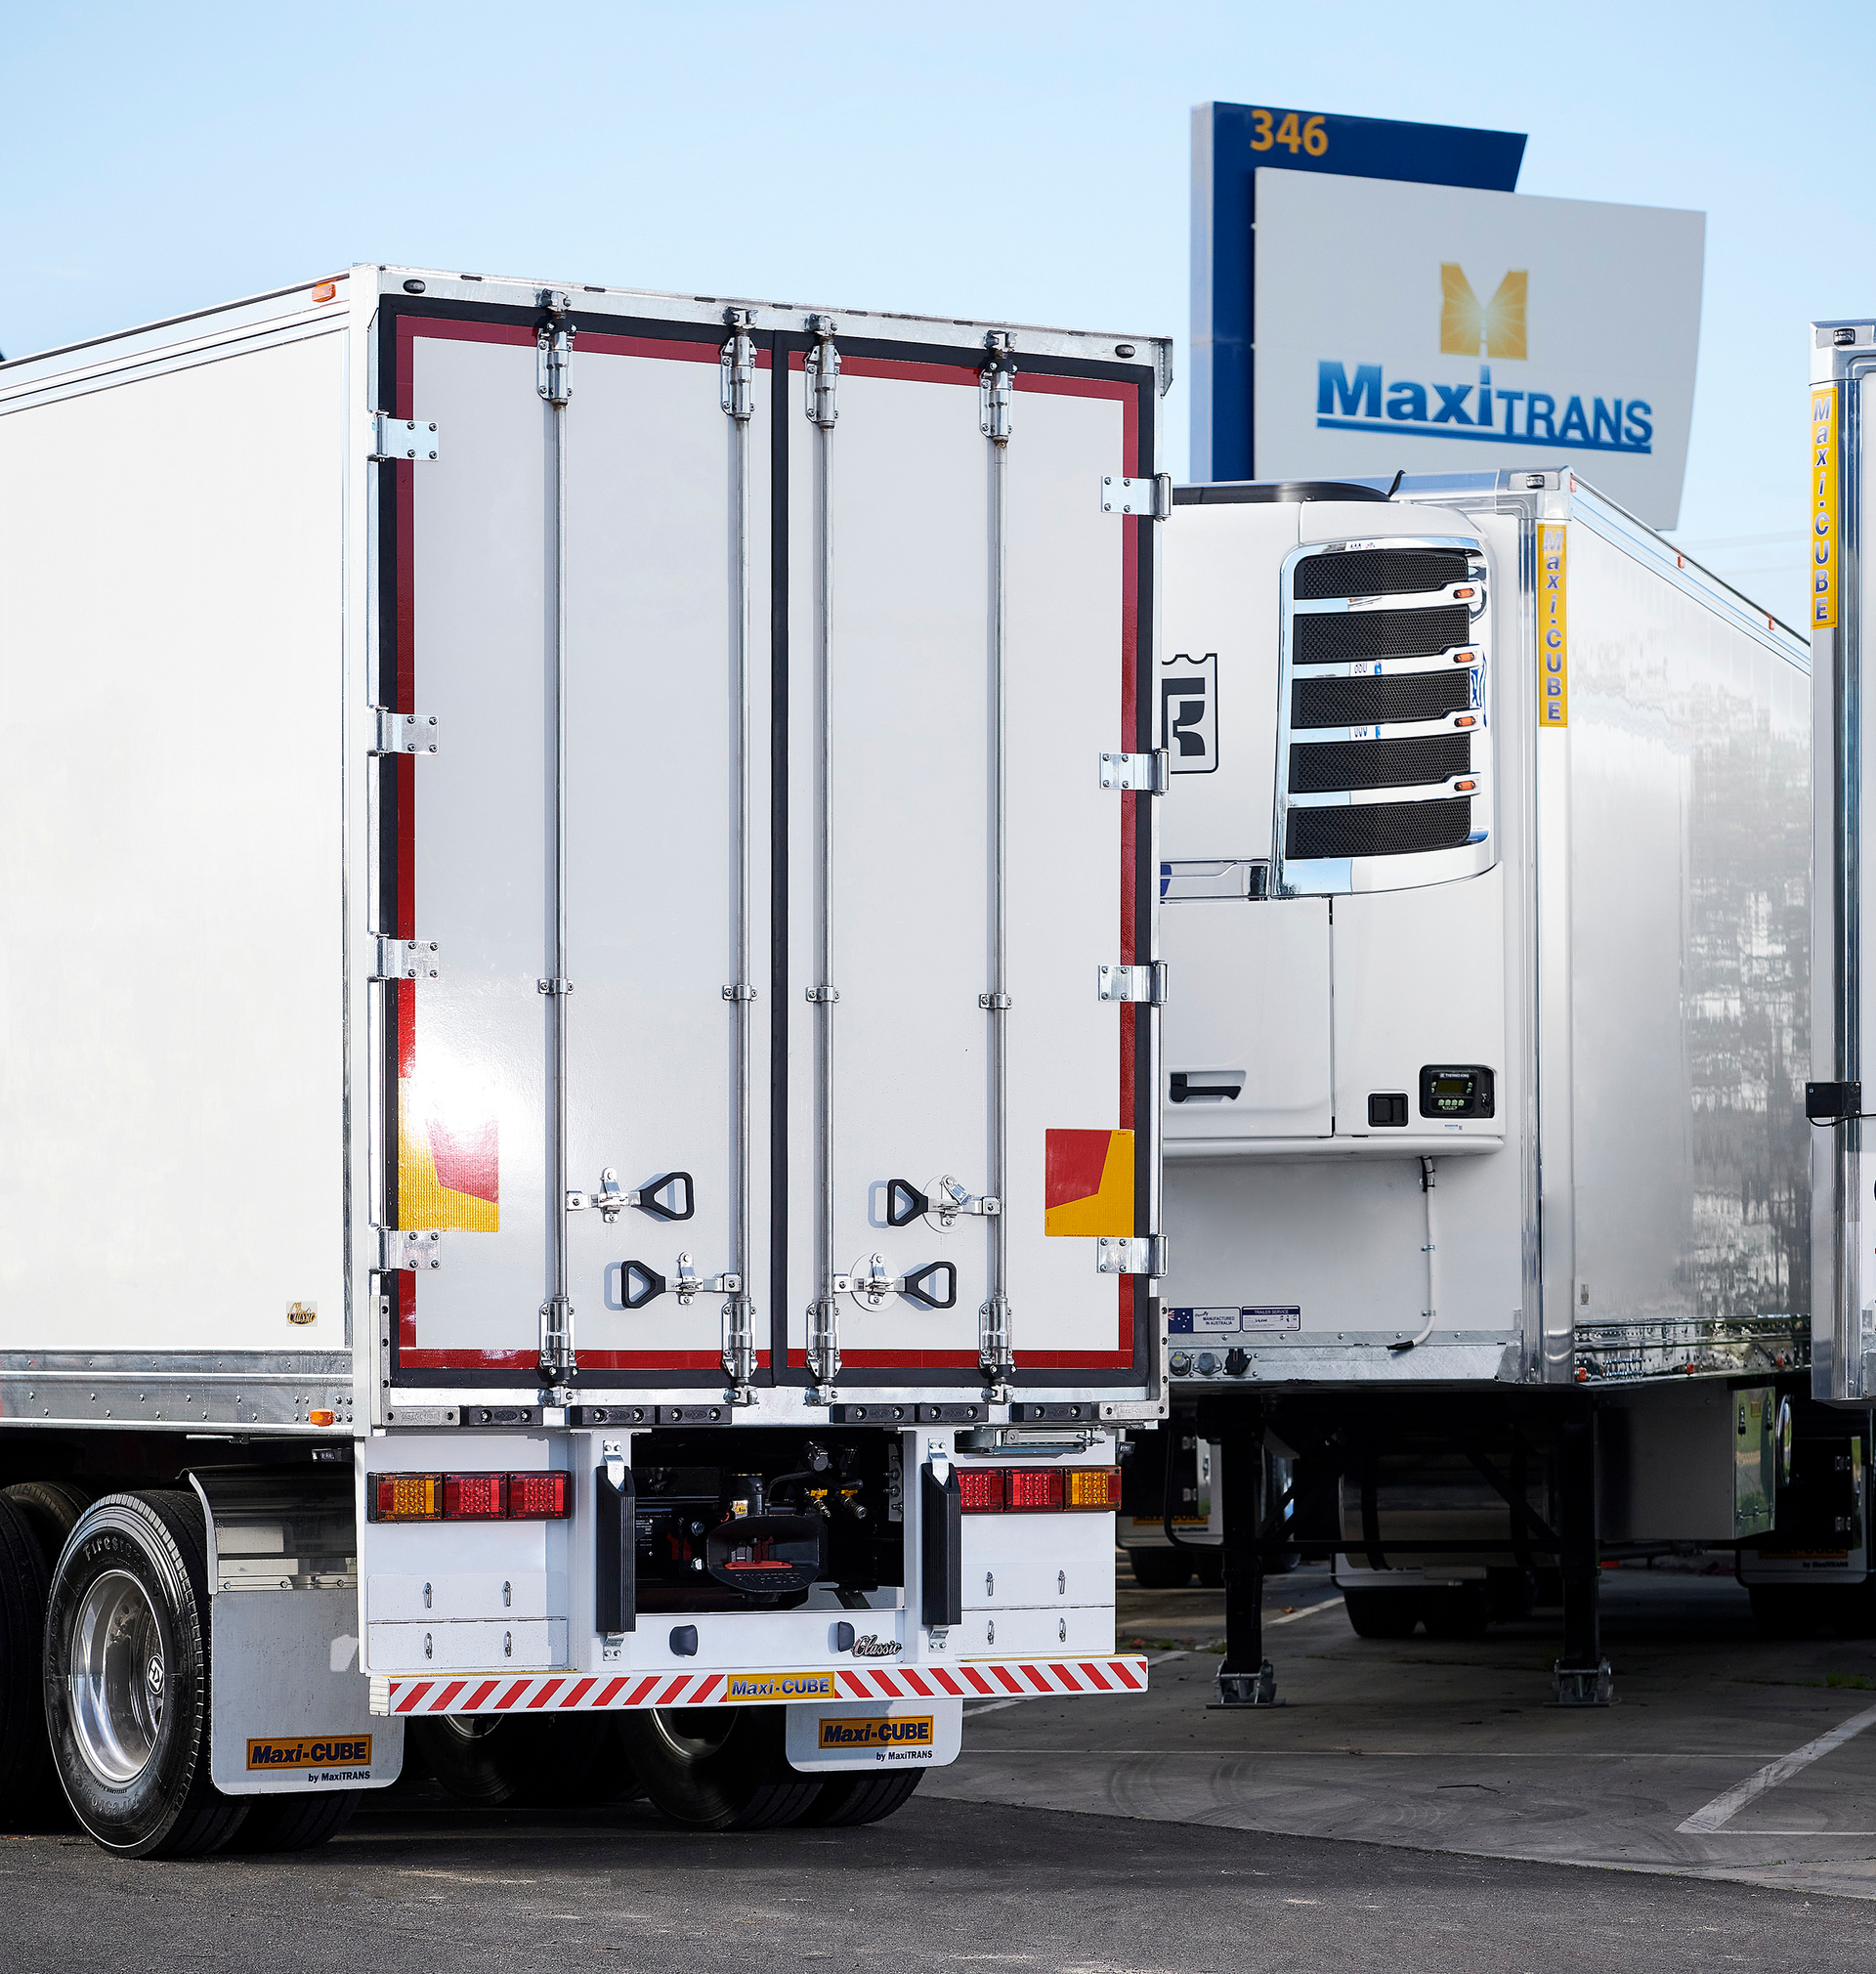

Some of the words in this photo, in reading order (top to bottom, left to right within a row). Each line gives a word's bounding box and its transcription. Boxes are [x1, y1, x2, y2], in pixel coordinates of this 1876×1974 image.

[1250, 109, 1329, 156] 346
[1316, 359, 1654, 448] MaxiTRANS
[851, 1634, 903, 1657] Classic
[732, 1678, 831, 1695] Maxi-CUBE
[823, 1722, 929, 1742] Maxi-CUBE
[251, 1741, 367, 1764] Maxi-CUBE
[876, 1752, 886, 1762] by
[888, 1750, 933, 1760] MaxiTRANS
[308, 1773, 319, 1783] by
[320, 1771, 371, 1781] MaxiTRANS
